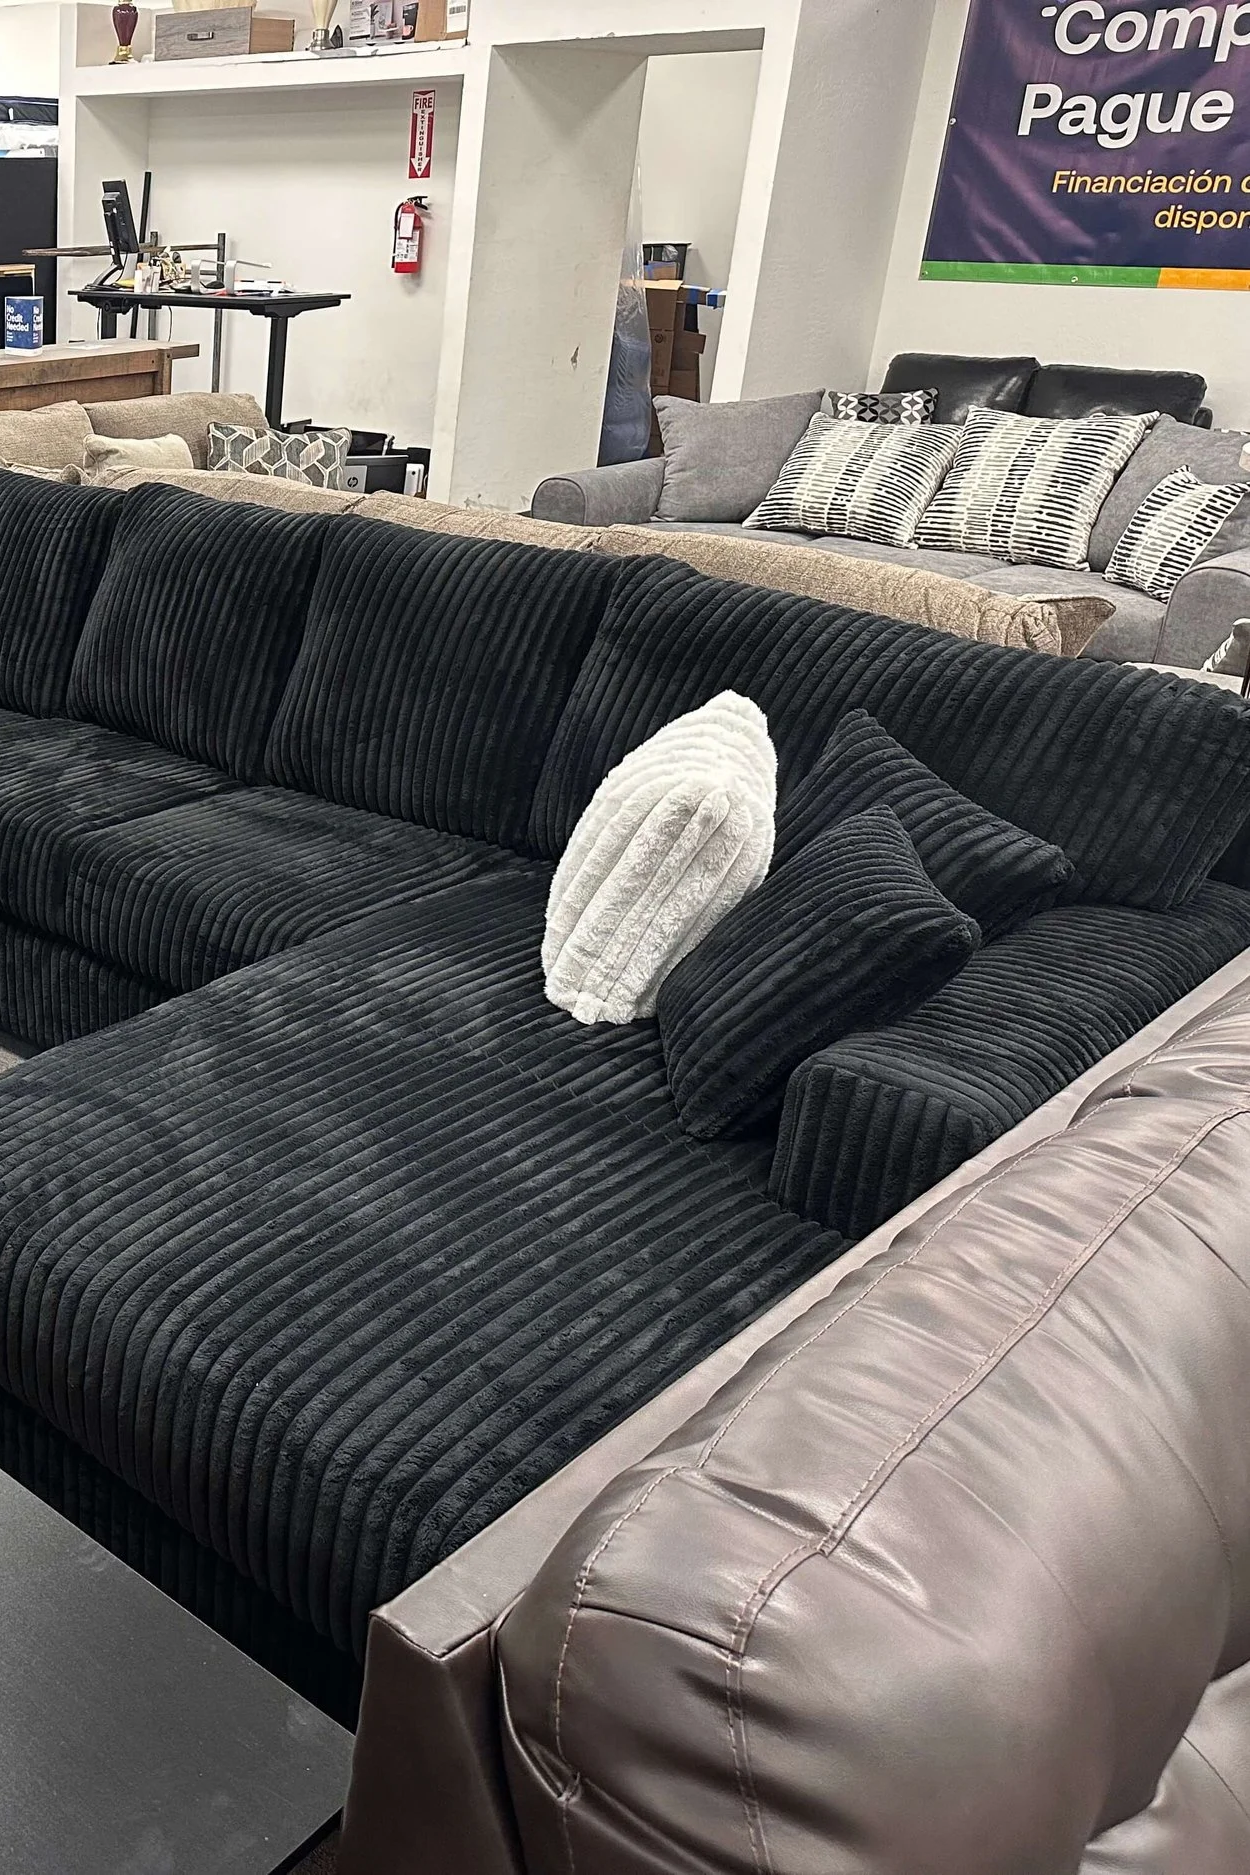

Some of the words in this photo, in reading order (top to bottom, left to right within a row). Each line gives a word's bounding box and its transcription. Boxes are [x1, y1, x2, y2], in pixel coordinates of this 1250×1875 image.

[414, 97, 433, 110] FIRE
[1017, 83, 1235, 149] Pague
[417, 109, 425, 172] EXTINGUISHER
[1051, 169, 1233, 194] Financiación
[6, 305, 15, 314] No
[6, 322, 29, 332] Needed
